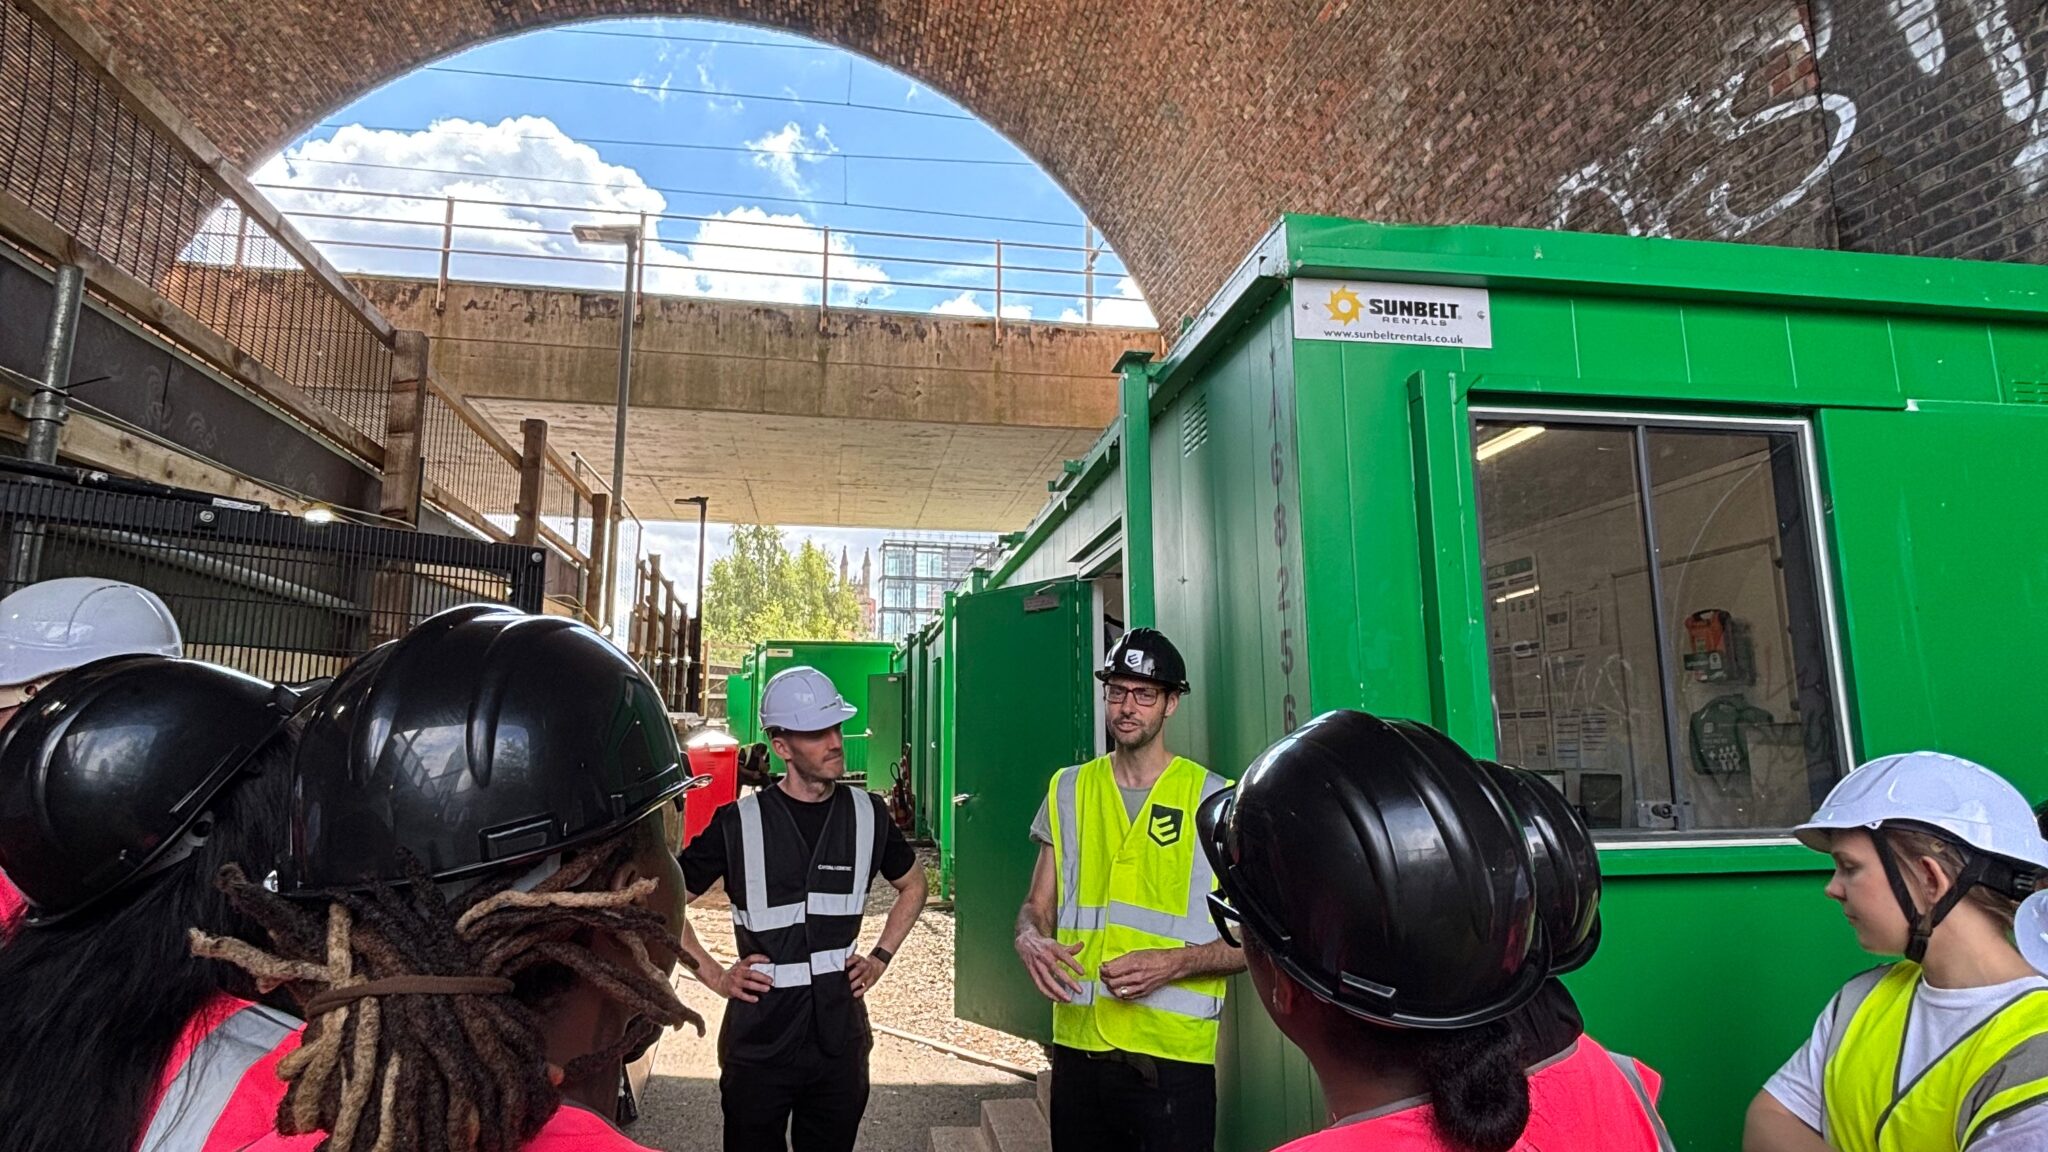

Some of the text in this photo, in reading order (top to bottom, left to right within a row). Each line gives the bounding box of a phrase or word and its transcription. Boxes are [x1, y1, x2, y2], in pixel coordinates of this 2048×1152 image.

[1368, 298, 1459, 320] SUNBELT
[1382, 316, 1447, 327] RENTALS
[1323, 330, 1464, 344] www.sunbeltrentals.co.uk
